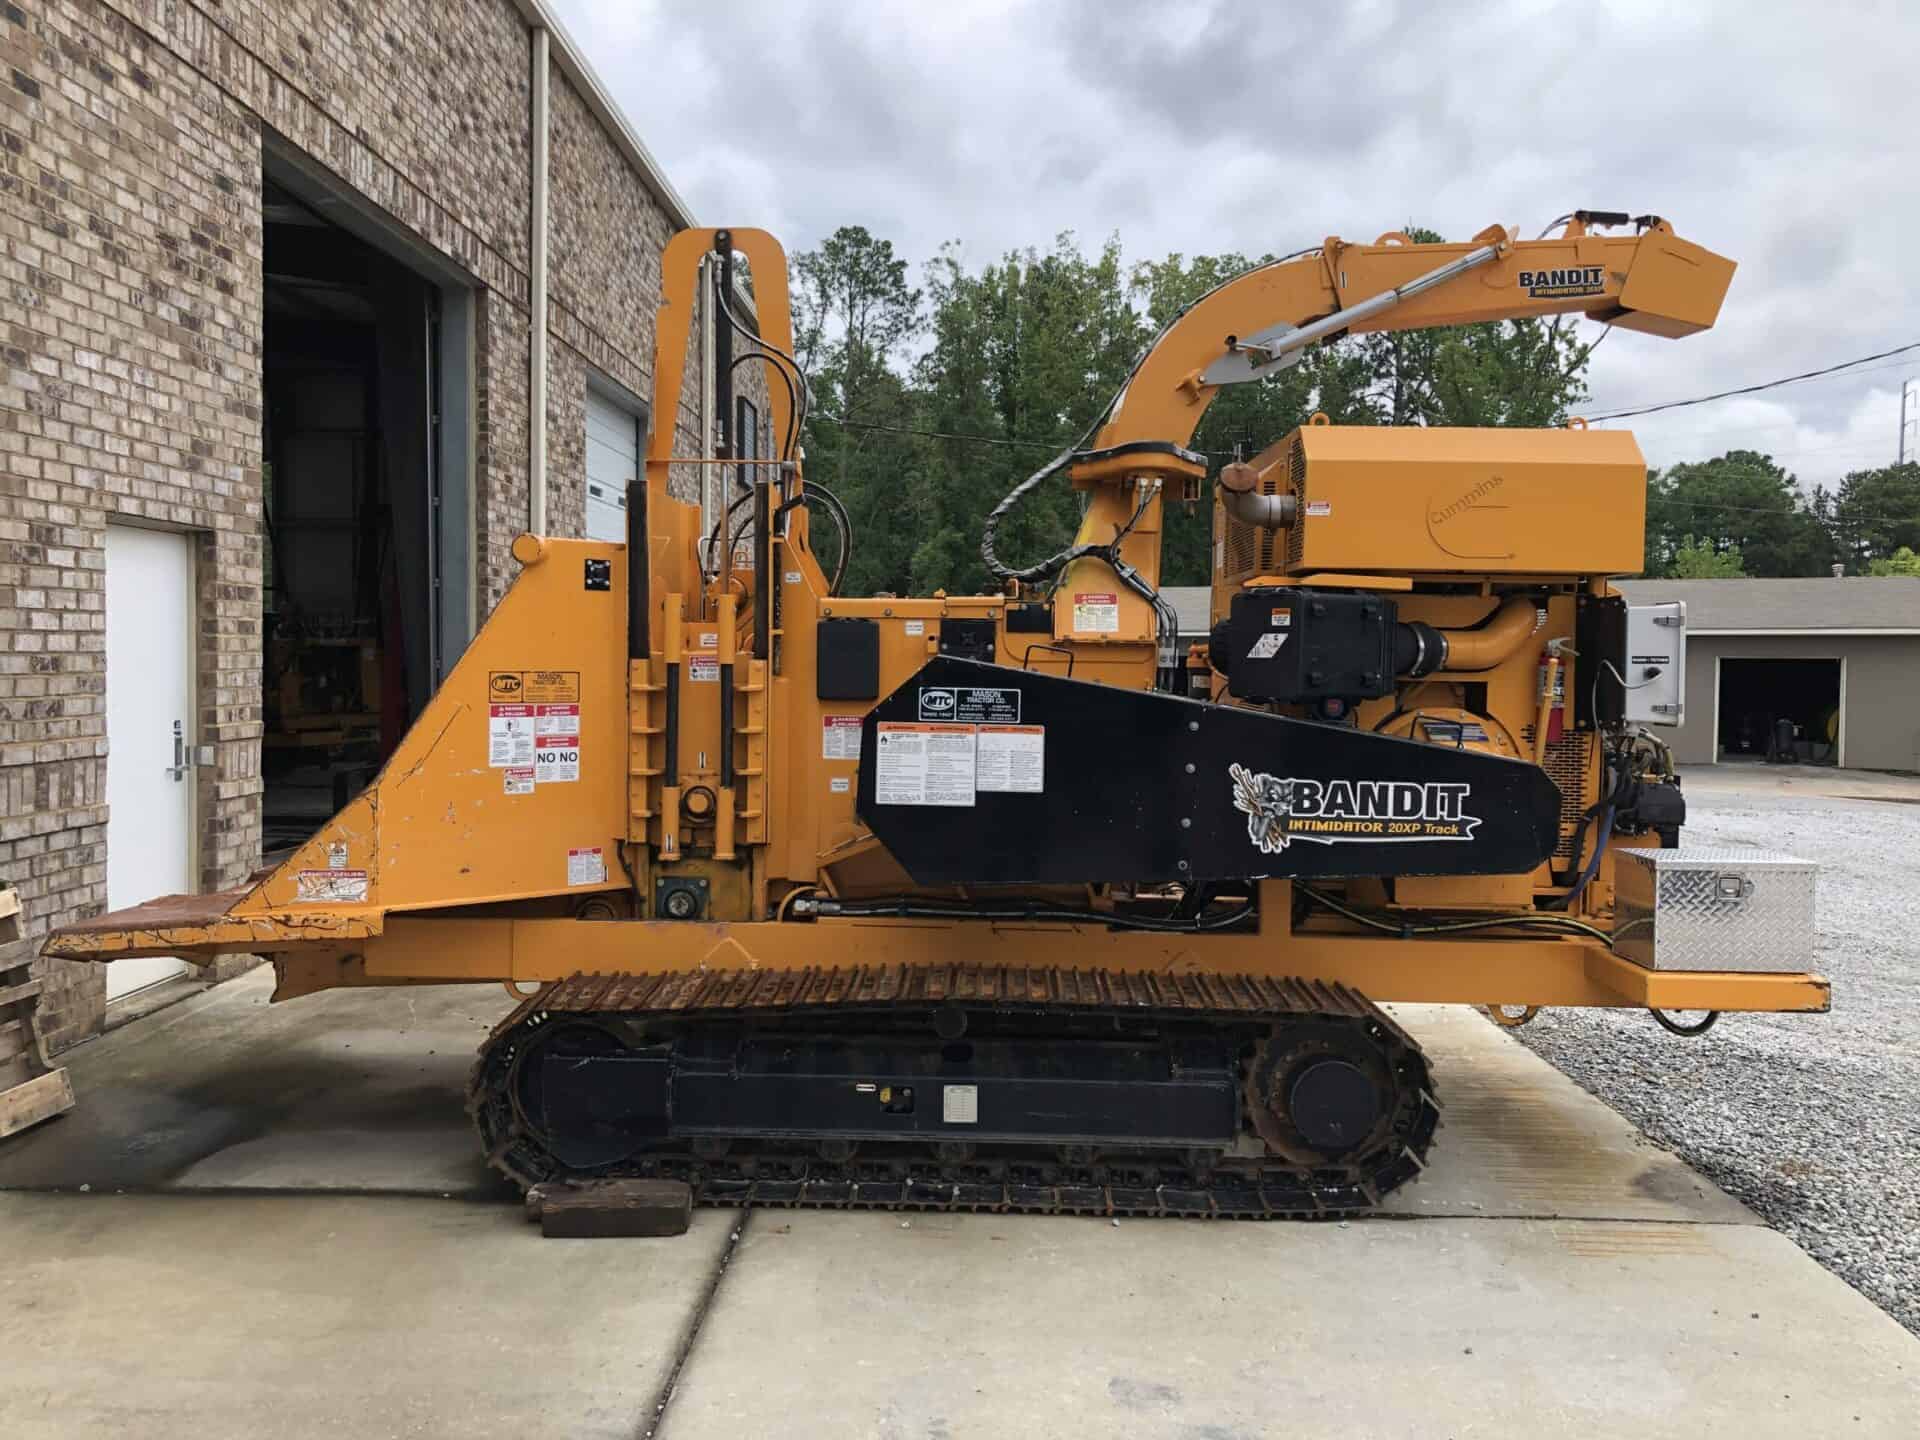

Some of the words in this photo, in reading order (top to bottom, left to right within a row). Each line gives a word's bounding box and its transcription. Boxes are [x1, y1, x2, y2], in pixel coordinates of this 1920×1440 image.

[1519, 268, 1603, 288] BANDIT
[537, 752, 556, 763] NO
[559, 751, 578, 762] NO
[1289, 779, 1470, 820] BANDIT
[1288, 819, 1384, 833] INTIMIDATOR
[1388, 823, 1421, 833] 20XP
[1425, 823, 1459, 835] Track
